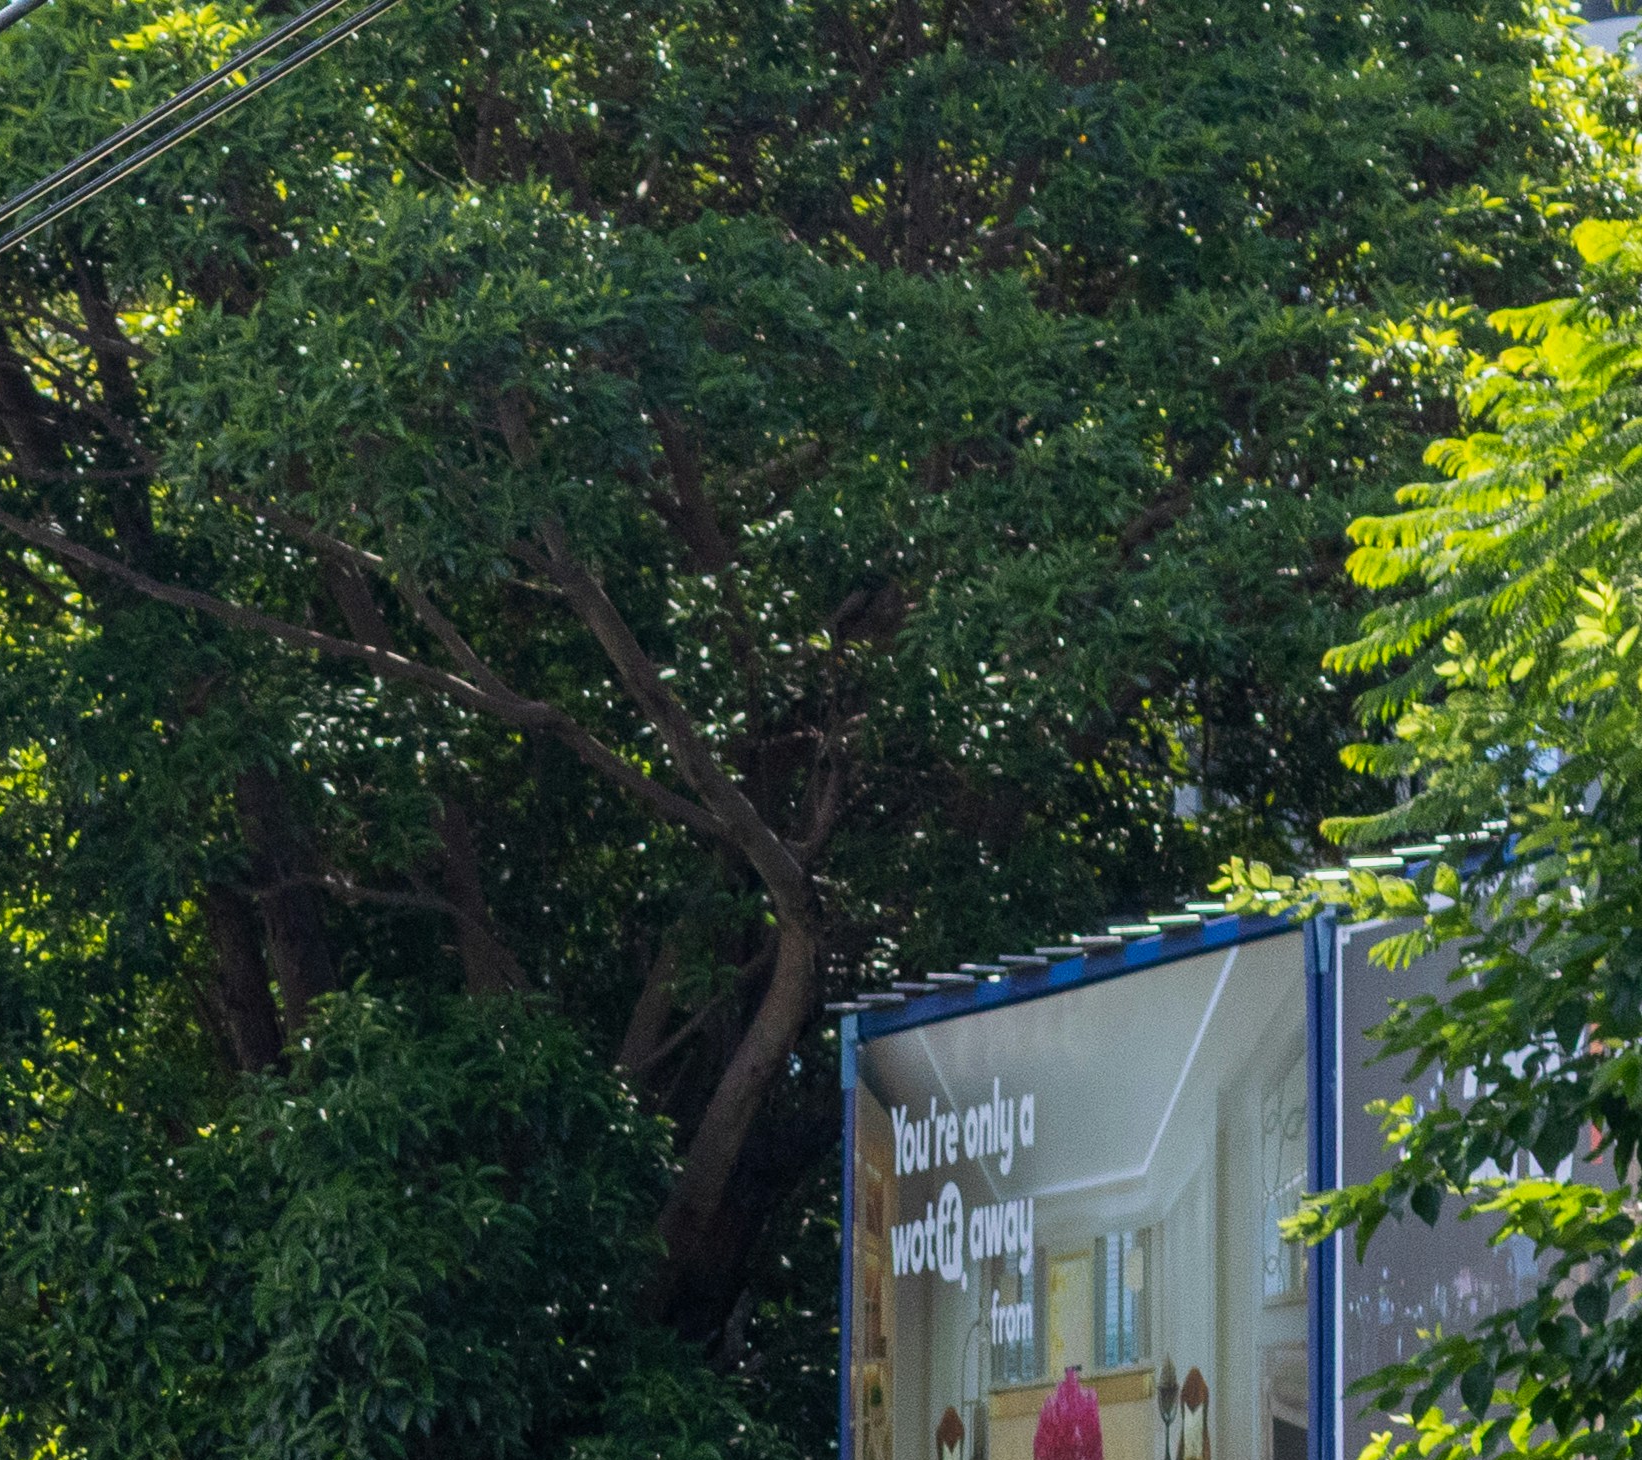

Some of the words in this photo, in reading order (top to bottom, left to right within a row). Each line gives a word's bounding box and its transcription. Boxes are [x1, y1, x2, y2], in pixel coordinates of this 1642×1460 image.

[892, 1097, 959, 1176] You're
[964, 1077, 1013, 1176] only
[1020, 1094, 1034, 1147] a
[970, 1198, 1034, 1276] away
[991, 1289, 1033, 1345] from
